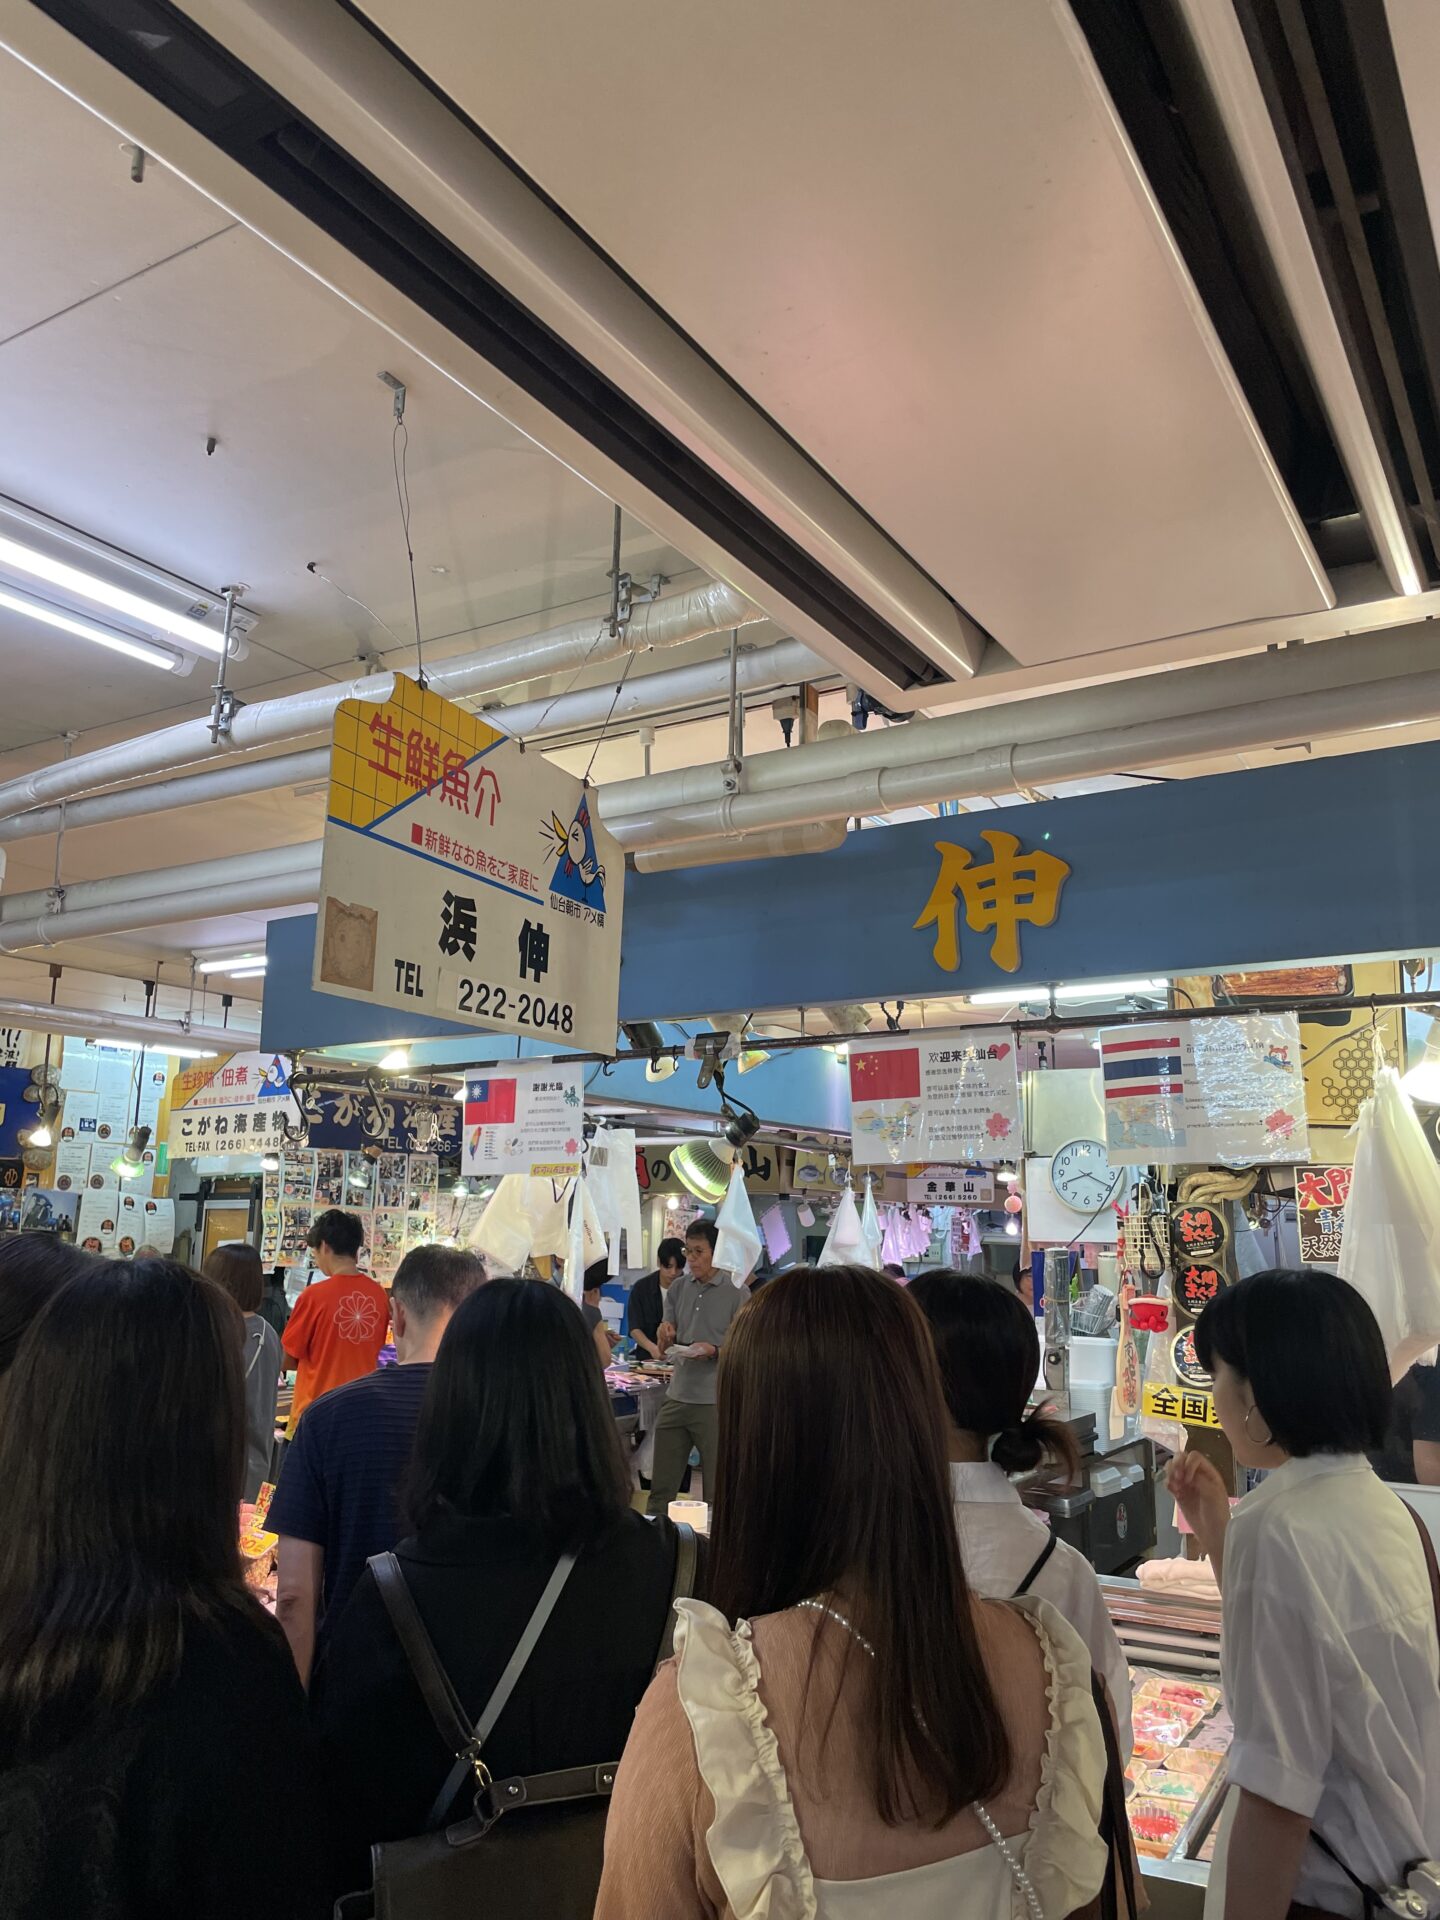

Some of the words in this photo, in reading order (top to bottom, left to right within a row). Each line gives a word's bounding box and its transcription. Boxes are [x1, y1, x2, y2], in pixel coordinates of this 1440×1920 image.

[368, 711, 502, 826] 生鮮魚介
[424, 828, 539, 893] 新鮮なお魚をご家庭に
[550, 894, 581, 919] 仙台朝市
[912, 830, 1072, 973] 伸
[394, 959, 424, 998] TEL
[458, 978, 574, 1034] 222-2048
[928, 1048, 998, 1063] 欢迎来仙台
[1061, 1156, 1071, 1166] 10
[1071, 1147, 1078, 1157] 11
[926, 1181, 974, 1193] 金華山
